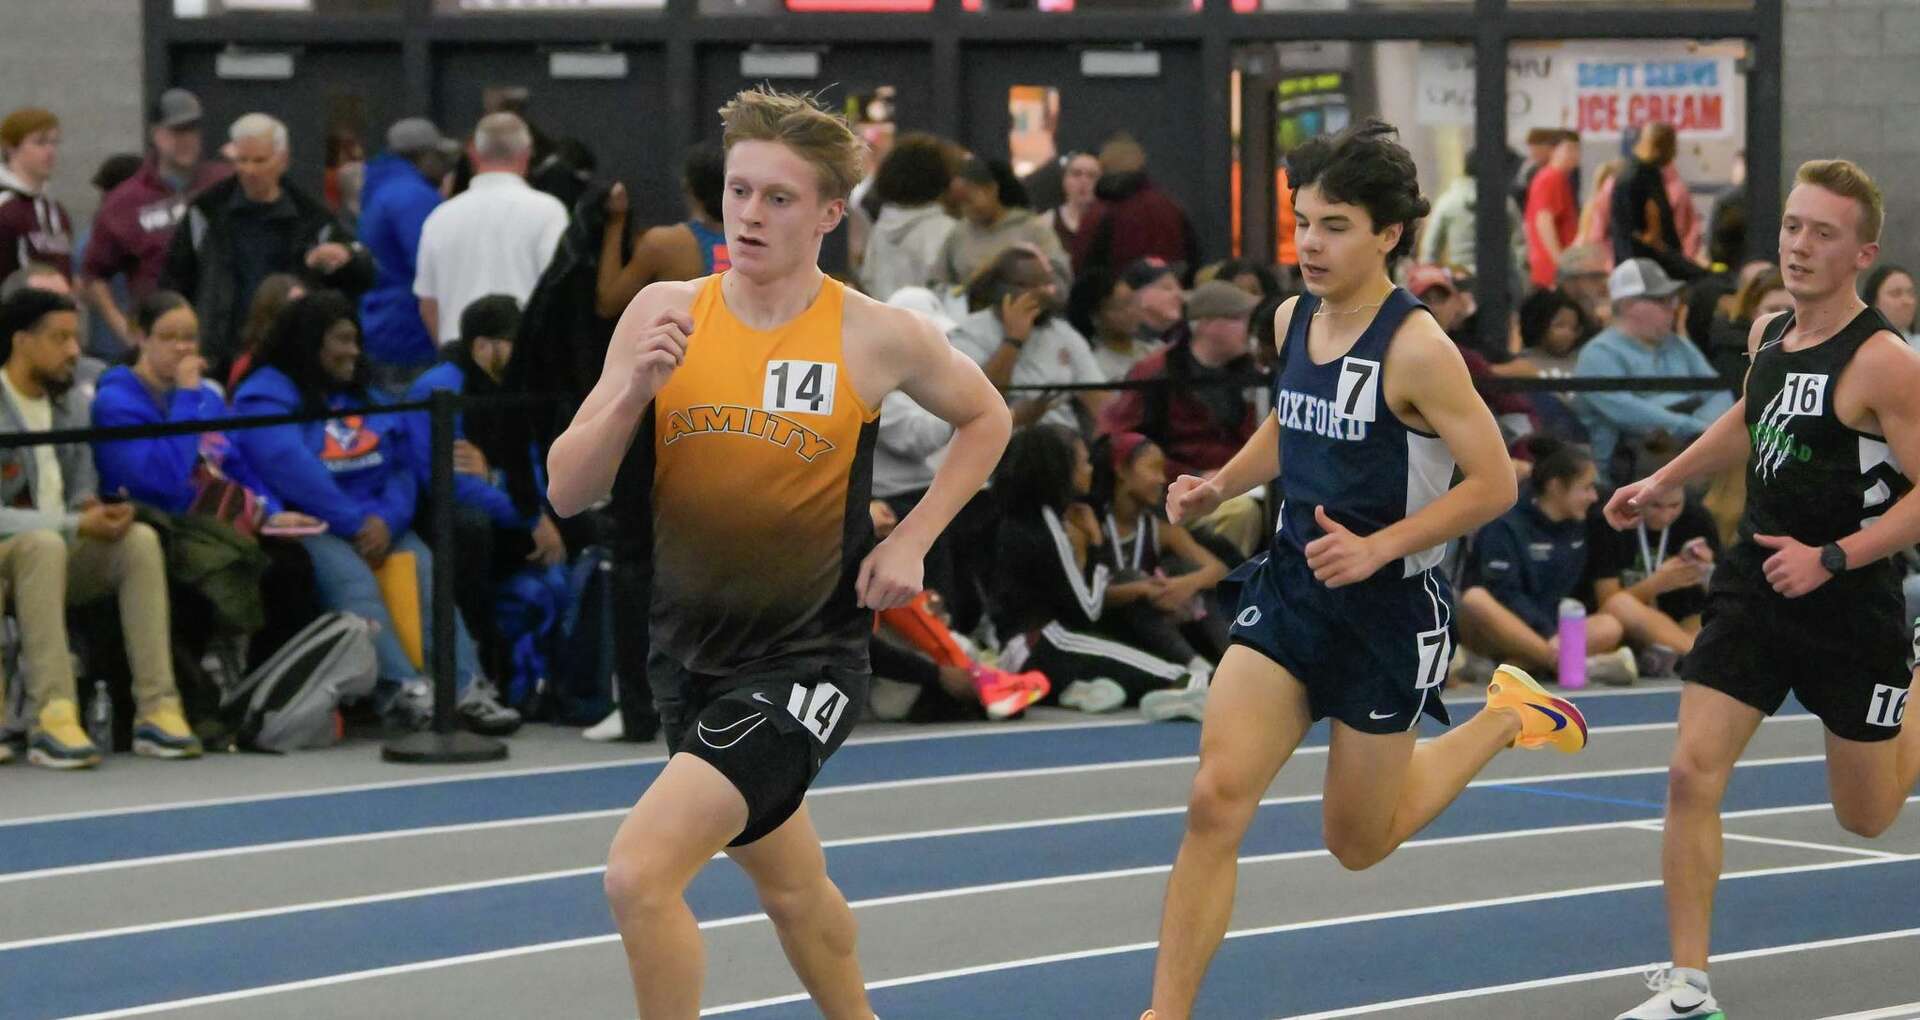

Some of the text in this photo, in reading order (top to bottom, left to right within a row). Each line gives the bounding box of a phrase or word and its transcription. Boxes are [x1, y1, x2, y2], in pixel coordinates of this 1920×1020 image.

[1577, 94, 1724, 132] ICE CREAM
[770, 362, 824, 411] 14
[1345, 362, 1374, 415] 7
[1788, 375, 1820, 413] 16
[665, 404, 836, 463] AMITY
[1422, 631, 1447, 684] 7
[797, 688, 841, 737] 14
